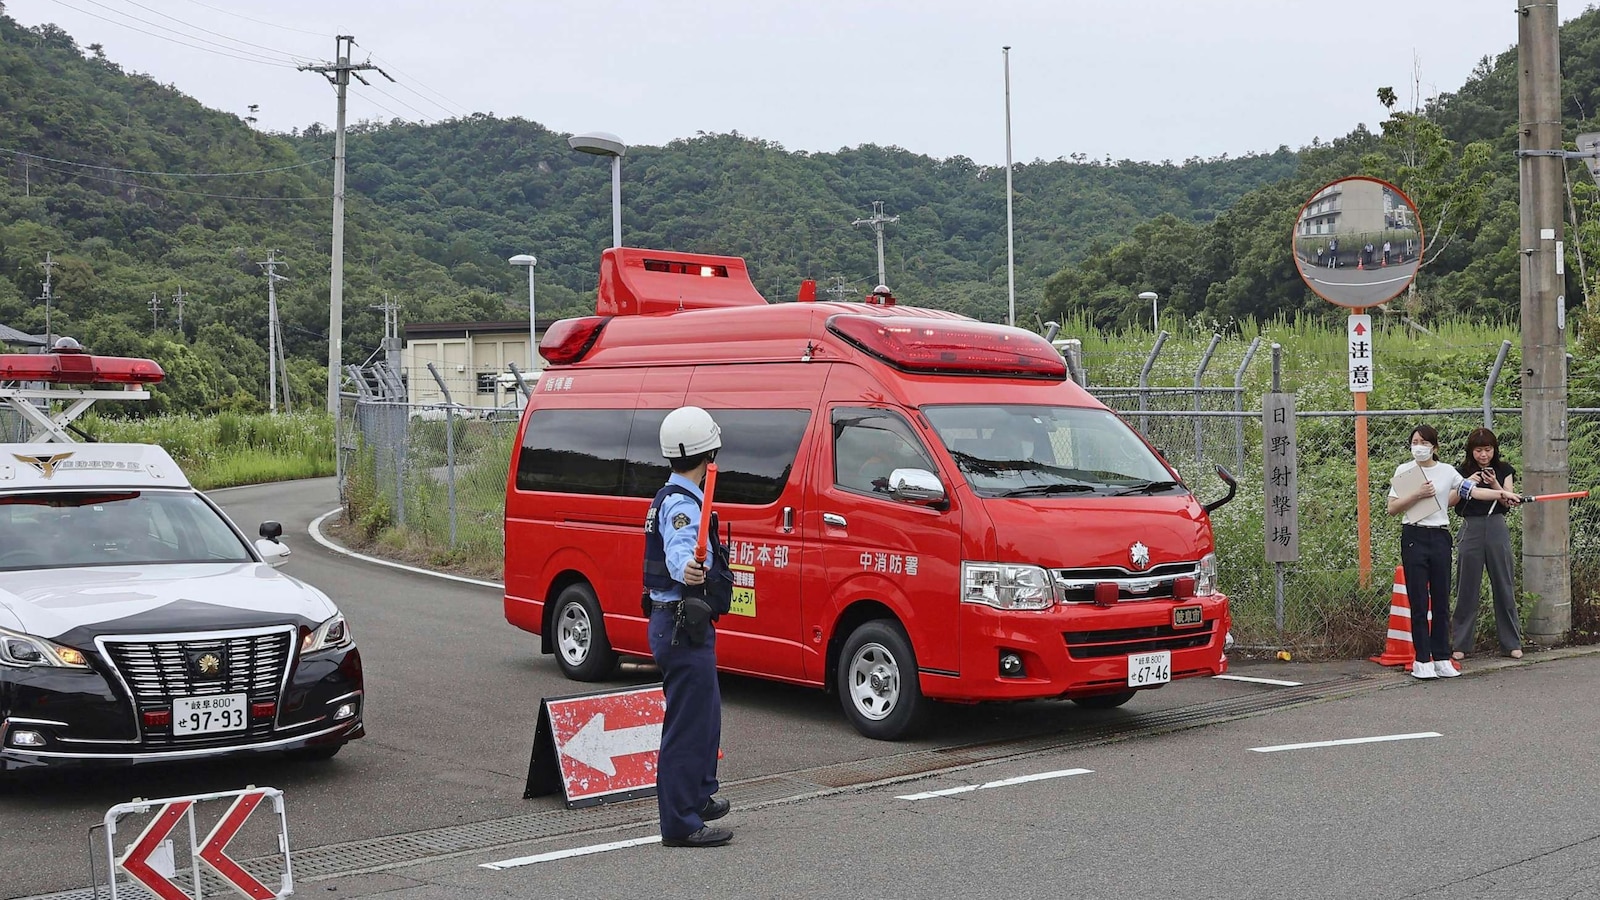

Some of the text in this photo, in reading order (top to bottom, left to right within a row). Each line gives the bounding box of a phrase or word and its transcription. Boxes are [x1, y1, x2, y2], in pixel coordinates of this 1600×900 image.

[1351, 341, 1370, 384] 注意
[544, 377, 574, 392] 指揮車
[1271, 407, 1292, 547] 日野射撃場
[860, 552, 918, 576] 中消防署
[1175, 608, 1200, 624] 岐阜市
